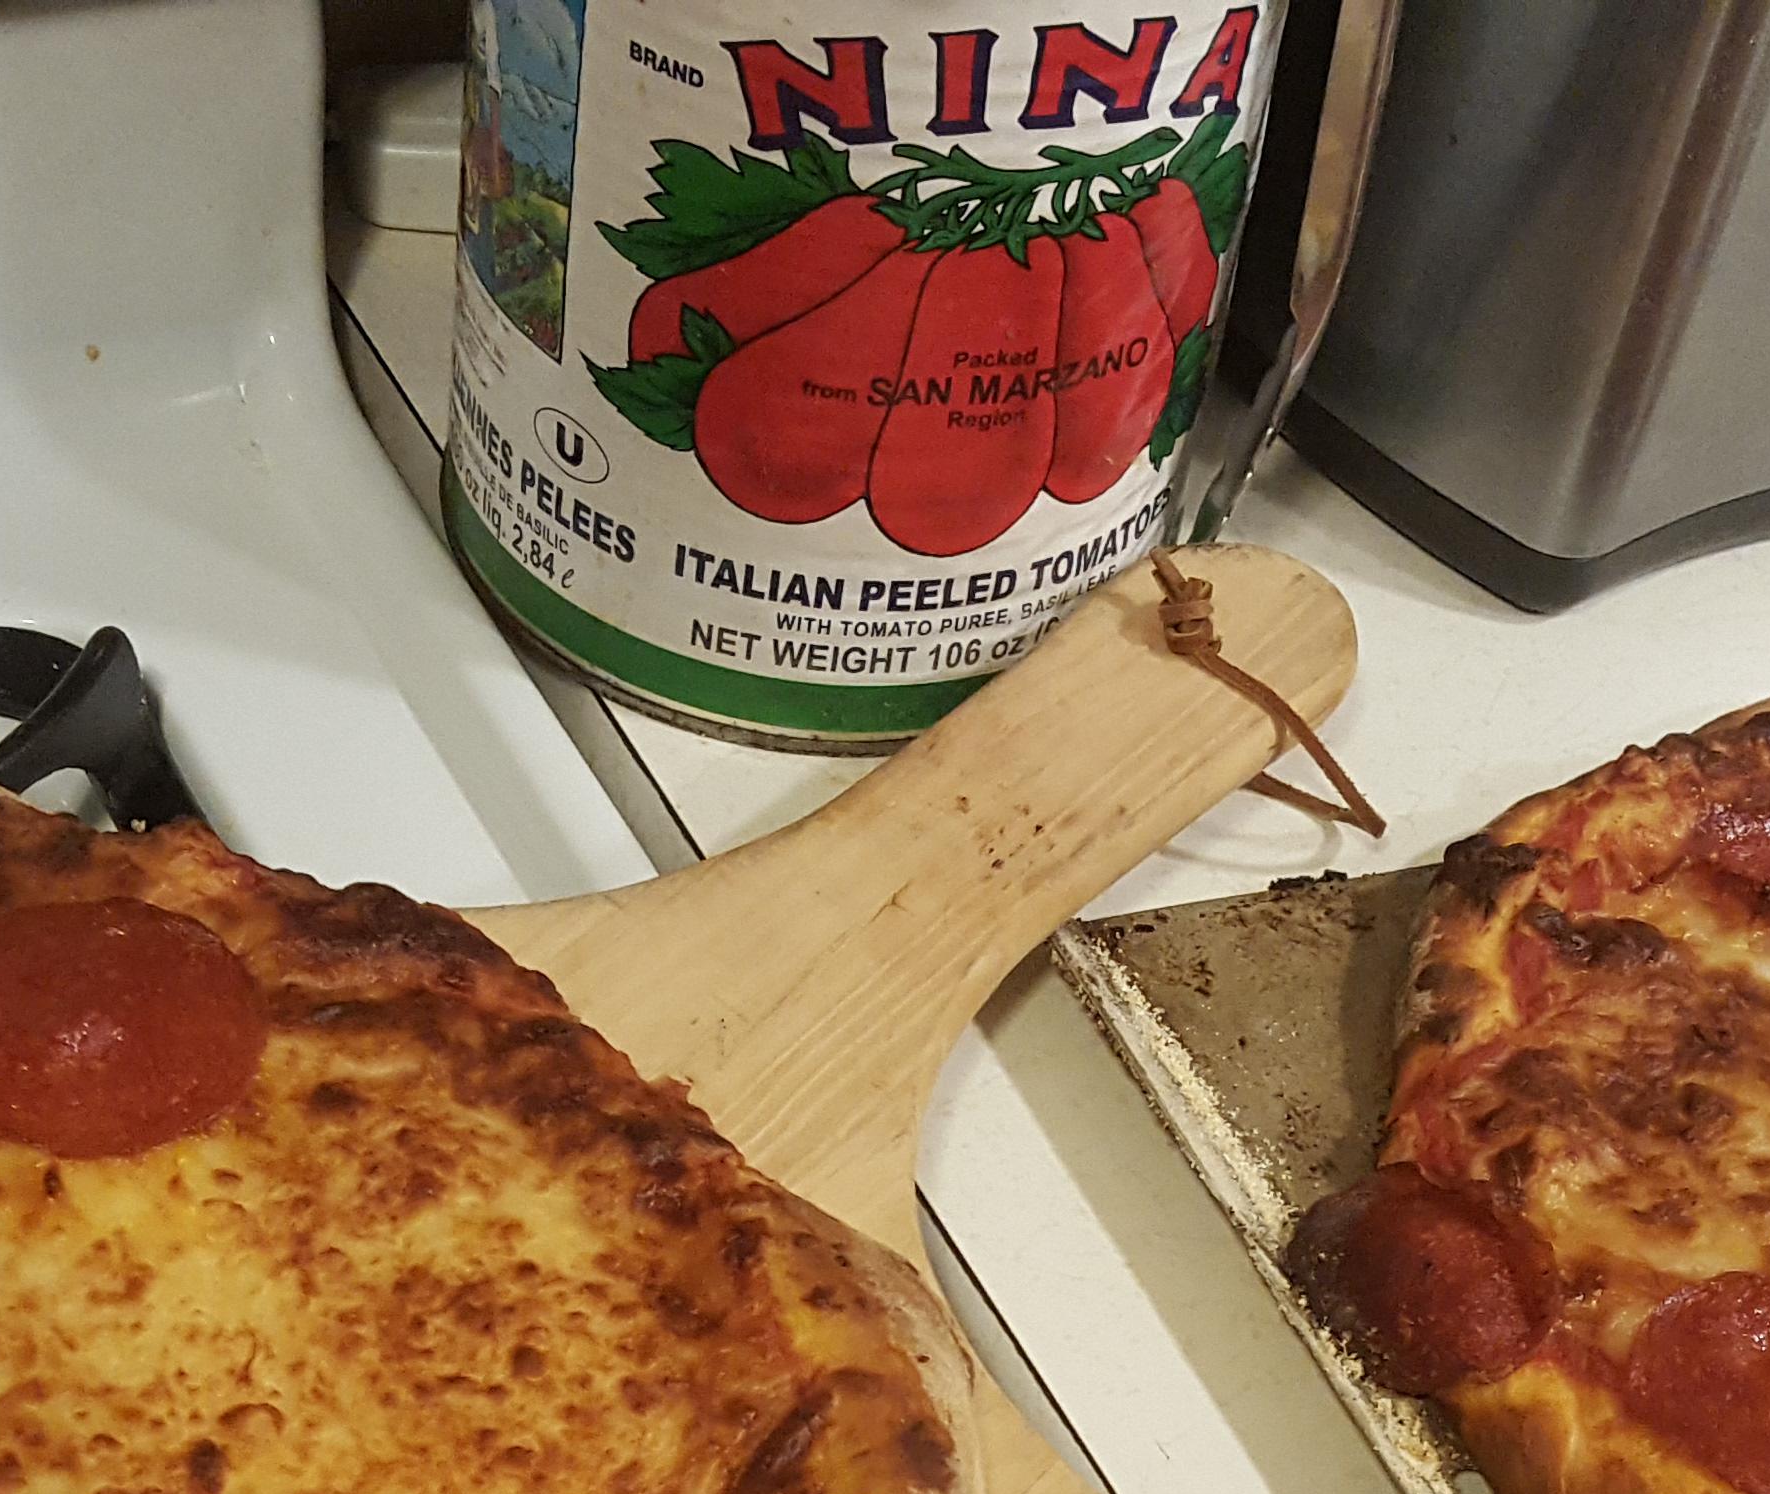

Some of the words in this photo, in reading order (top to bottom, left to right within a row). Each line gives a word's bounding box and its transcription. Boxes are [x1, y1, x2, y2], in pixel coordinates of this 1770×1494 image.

[629, 39, 705, 90] BRAND
[719, 5, 1259, 151] NINA
[802, 379, 857, 404] from
[866, 376, 953, 406] SAN
[968, 336, 1149, 405] MARZANO
[952, 346, 1038, 370] Packed
[556, 421, 584, 467] U
[947, 409, 1027, 432] Region
[516, 502, 569, 556] BASILIC
[520, 459, 636, 563] PELEES
[512, 524, 555, 579] 2,84
[674, 543, 845, 611] ITALIAN
[858, 569, 1018, 612] PEELED
[776, 612, 831, 635] WITH
[840, 619, 932, 637] TOMATO
[939, 608, 1012, 634] PUREE,
[1020, 592, 1071, 620] BASIL
[690, 618, 762, 661] NET
[772, 638, 917, 674] WEIGHT
[929, 639, 982, 671] 106
